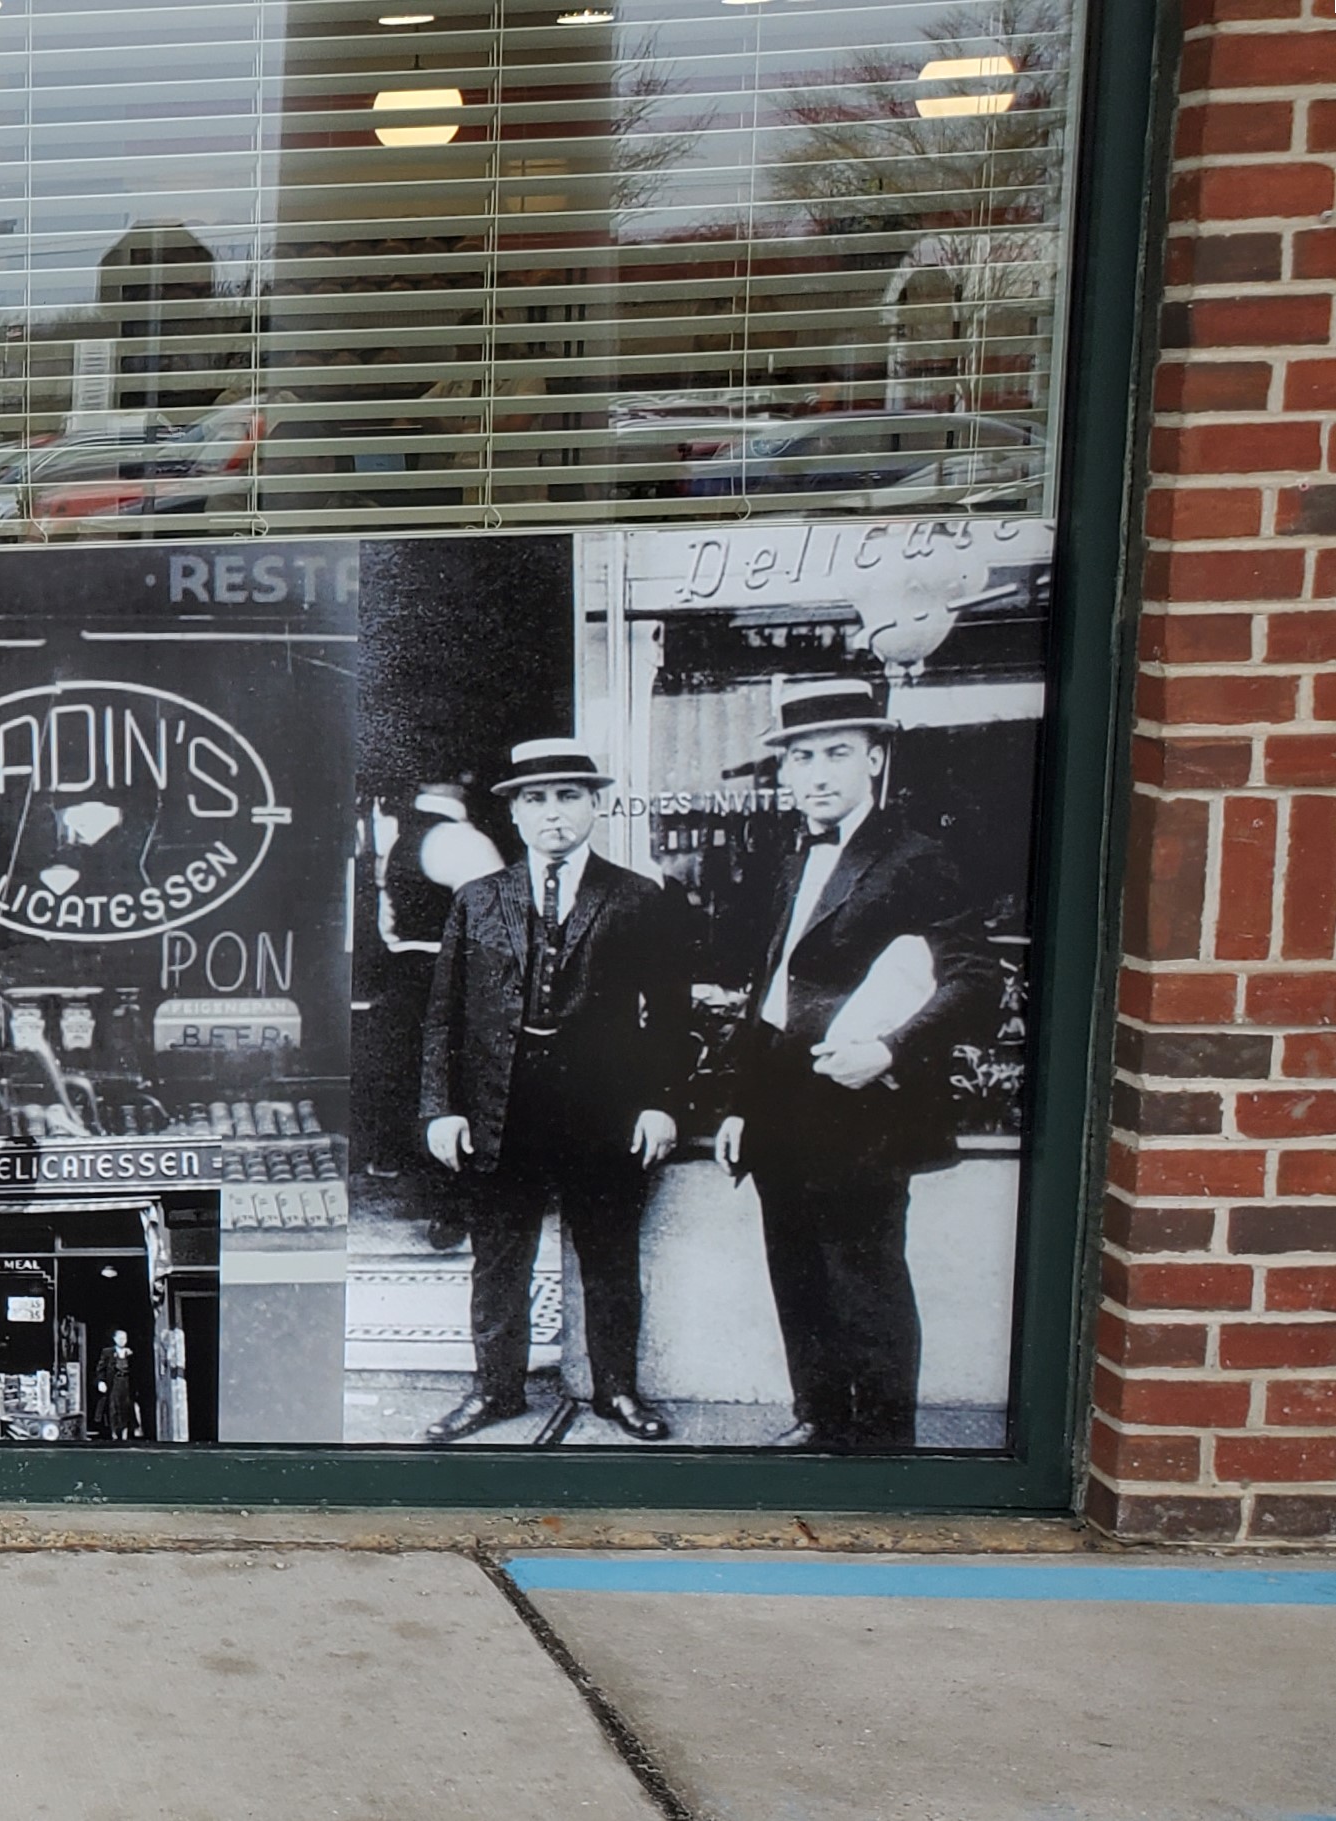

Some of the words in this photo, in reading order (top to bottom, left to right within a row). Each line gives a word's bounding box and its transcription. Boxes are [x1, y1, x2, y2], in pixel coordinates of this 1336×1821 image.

[598, 792, 693, 818] ADIES
[161, 930, 293, 992] PON
[4, 1260, 41, 1270] MEAL
